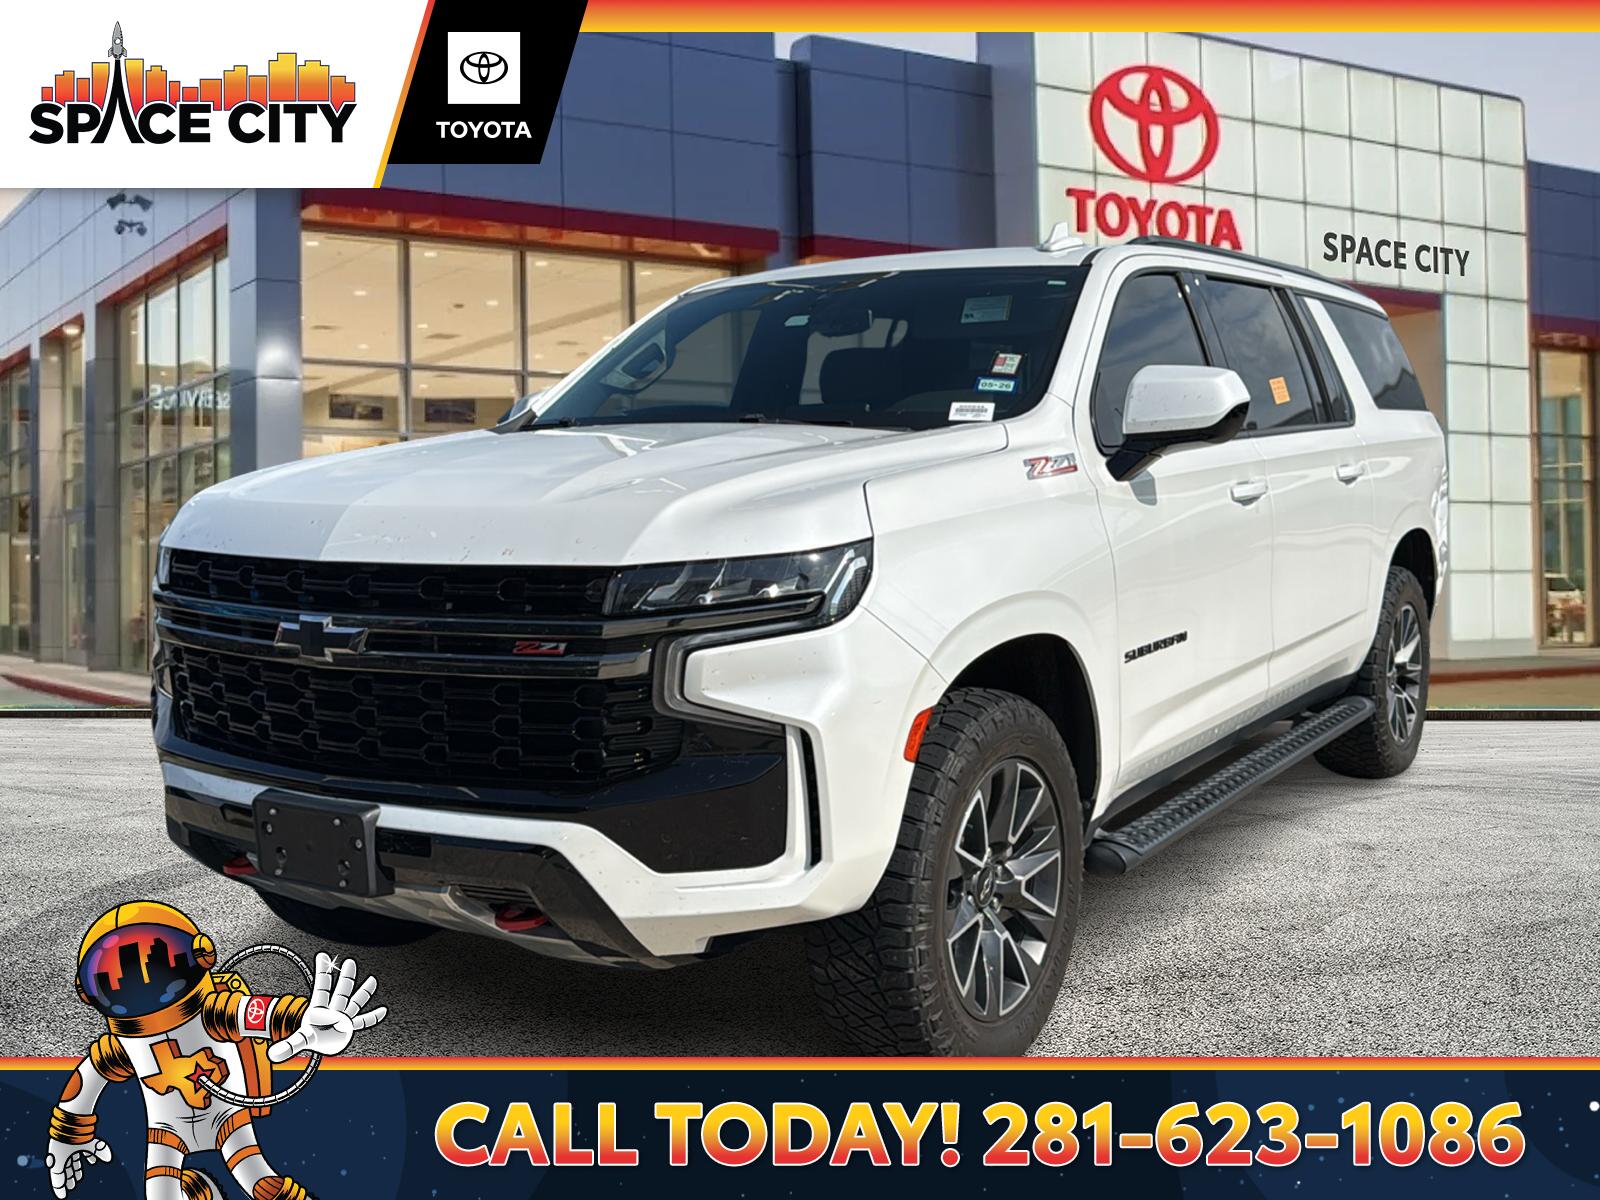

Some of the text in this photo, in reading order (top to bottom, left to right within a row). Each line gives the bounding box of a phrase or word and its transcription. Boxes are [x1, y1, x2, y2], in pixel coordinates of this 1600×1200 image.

[1066, 187, 1243, 252] TOYOTA
[1323, 232, 1471, 277] SPACE CITY
[1123, 630, 1189, 664] SUBURBAN
